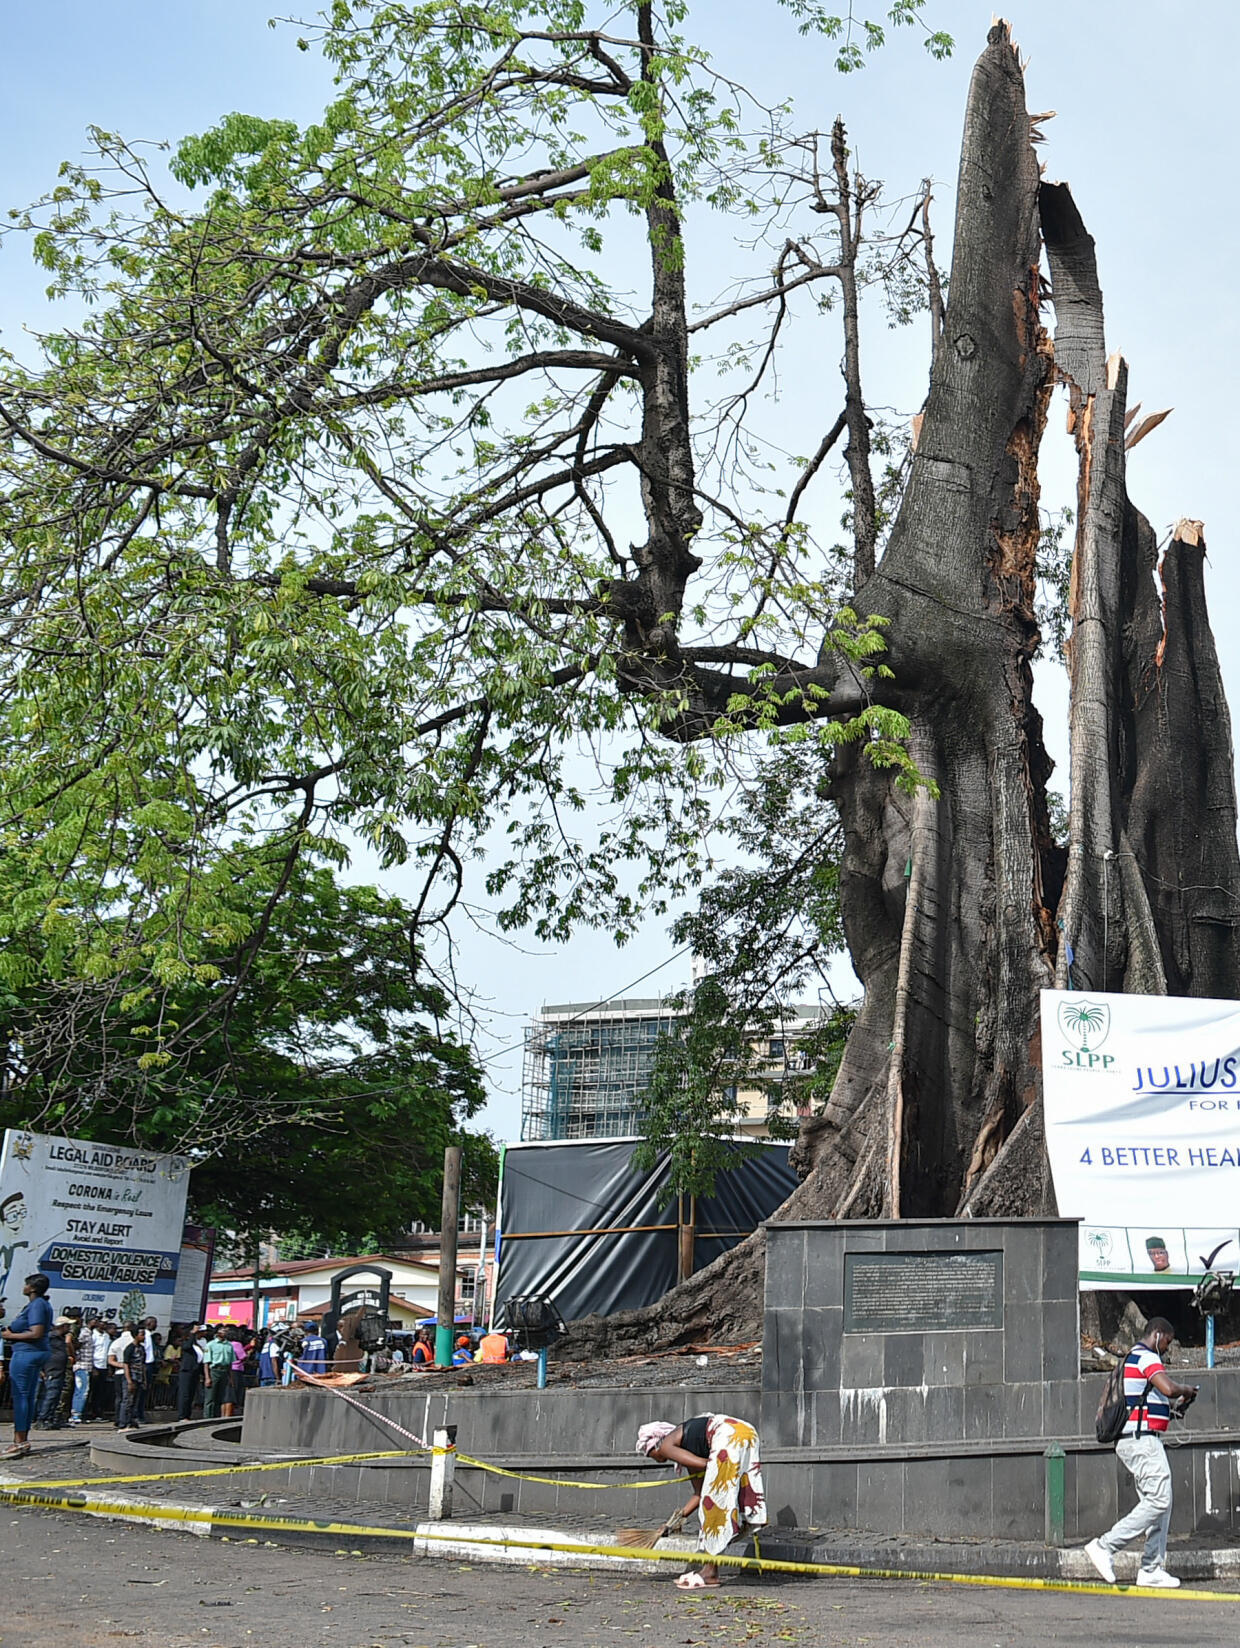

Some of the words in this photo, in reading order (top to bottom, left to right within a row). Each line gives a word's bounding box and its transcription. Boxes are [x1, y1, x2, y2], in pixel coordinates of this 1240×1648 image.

[1062, 1050, 1115, 1069] SLPP
[1132, 1057, 1237, 1091] JULIUS
[1189, 1100, 1228, 1111] FOR
[50, 1145, 88, 1164] LEGAL
[91, 1151, 113, 1167] AID
[115, 1154, 157, 1173] BOARD
[1079, 1146, 1093, 1166] 4
[1101, 1147, 1181, 1166] BETTER
[68, 1184, 112, 1200] CORONA
[66, 1219, 96, 1234] STAY
[97, 1222, 132, 1237] ALERT
[73, 1234, 92, 1243] Avoid
[93, 1236, 103, 1244] and
[104, 1236, 124, 1246] Report
[51, 1247, 109, 1264] DOMESTIC
[111, 1252, 161, 1268] VIOLENCE
[62, 1265, 111, 1281] SEXUAL
[113, 1268, 157, 1284] ABUSE
